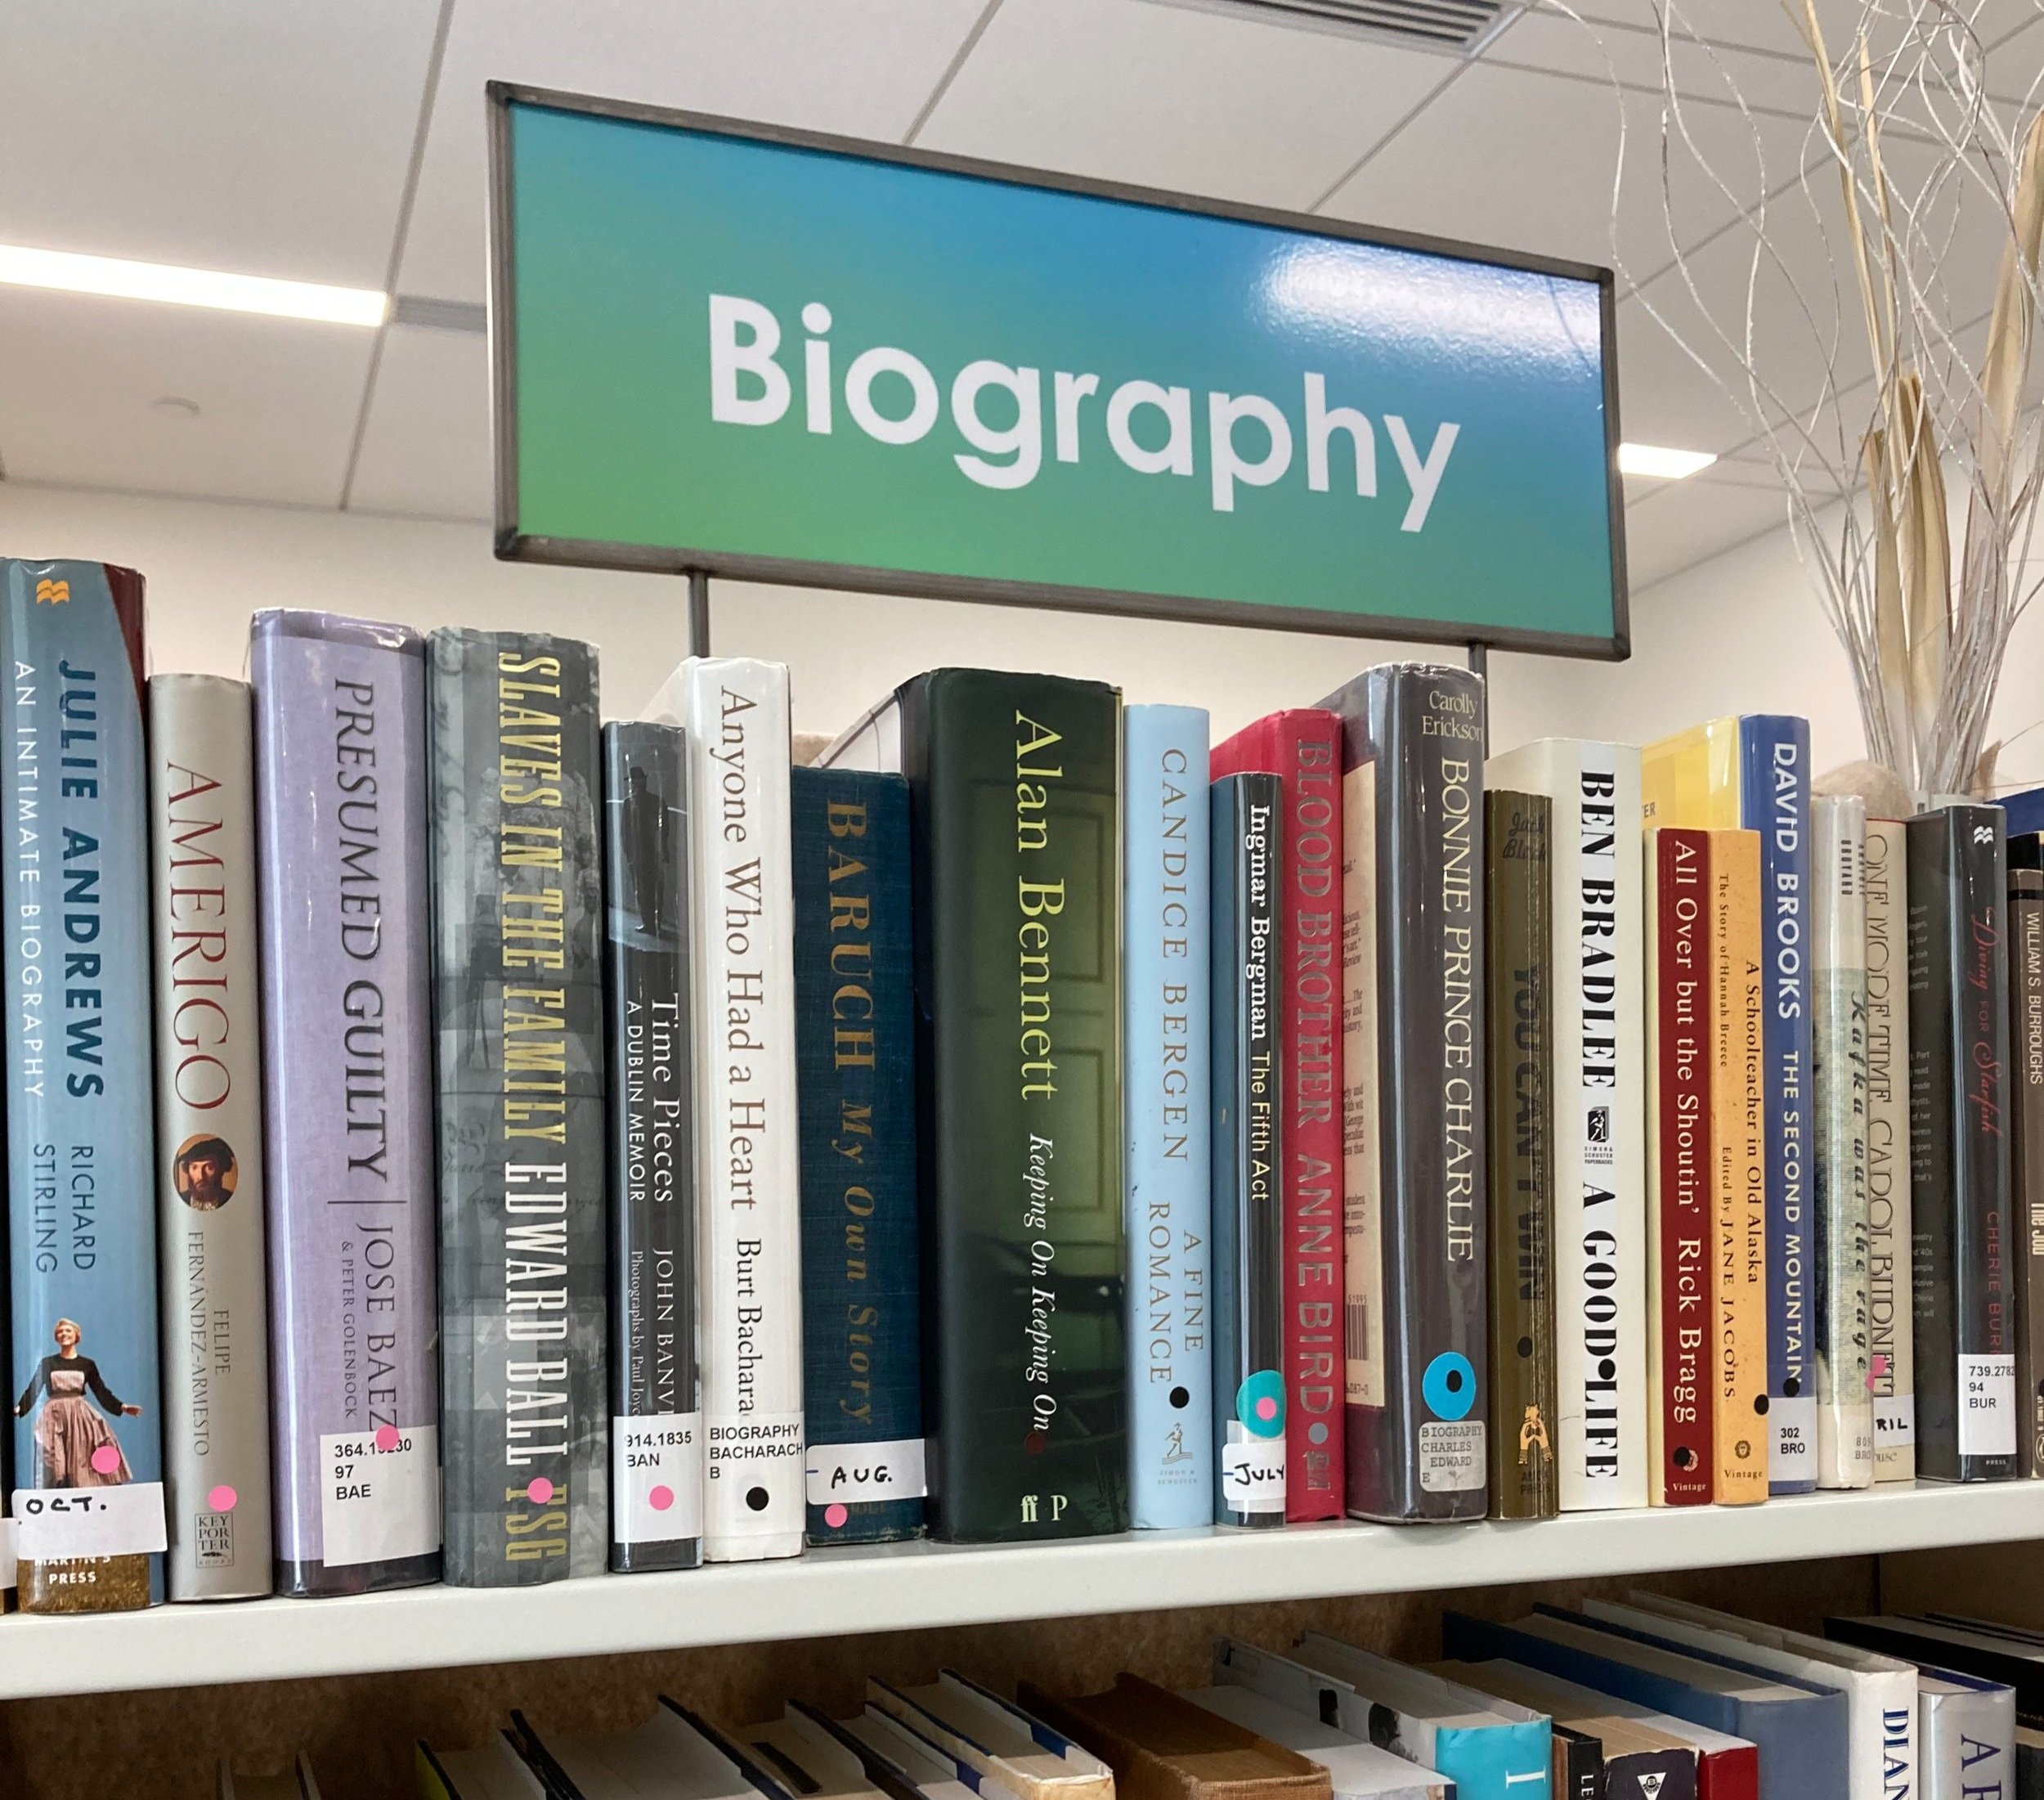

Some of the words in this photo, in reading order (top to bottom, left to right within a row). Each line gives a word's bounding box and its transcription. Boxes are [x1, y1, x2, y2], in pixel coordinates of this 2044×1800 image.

[707, 294, 1461, 532] Biography
[15, 660, 37, 707] AN
[1429, 690, 1478, 720] Carolly
[59, 658, 98, 801] JULIE
[499, 652, 562, 809] SLAVES
[710, 685, 758, 843] Anyone
[1422, 715, 1483, 743] Erickson
[16, 727, 40, 883] INTIMATE
[1015, 710, 1063, 853] Alan
[1296, 738, 1333, 898] BLOOD
[1580, 770, 1615, 859] BEN
[1773, 742, 1798, 853] DAVID
[334, 678, 382, 962] PRESUMED
[500, 823, 563, 872] IN
[1162, 748, 1188, 959] CANDICE
[1441, 756, 1471, 913] BONNIE
[1245, 805, 1271, 909] Ingmar
[1674, 840, 1697, 885] All
[1719, 873, 1728, 897] The
[1841, 839, 1853, 895] BROYARD
[1866, 834, 1889, 904] ONE
[167, 761, 231, 1110] AMERIGO
[502, 888, 564, 971] THE
[724, 856, 761, 955] Who
[827, 799, 876, 1071] BARUCH
[1675, 897, 1698, 970] Over
[1719, 904, 1730, 941] Story
[2027, 912, 2041, 972] WILLIAM
[61, 825, 105, 1098] ANDREWS
[1245, 916, 1271, 1042] Bergman
[1582, 878, 1616, 1088] BRADLEE
[1719, 945, 1729, 962] of
[1746, 960, 1760, 976] A
[1777, 873, 1800, 1020] BROOKS
[1971, 907, 1997, 990] Diving
[2028, 976, 2040, 990] S.
[20, 904, 44, 1098] BIOGRAPHY
[626, 1000, 640, 1017] A
[727, 968, 764, 1052] Had
[1018, 875, 1065, 1101] Bennett
[1297, 909, 1333, 1129] BROTHER
[1443, 925, 1472, 1069] PRINCE
[1514, 965, 1541, 1053] YOU
[1676, 981, 1698, 1026] but
[1719, 966, 1729, 1019] Hannah
[1978, 1002, 1988, 1032] FOR
[503, 985, 567, 1144] FAMILY
[627, 1025, 643, 1103] DUBLIN
[652, 992, 679, 1084] Time
[1163, 983, 1189, 1162] BERGEN
[1251, 1051, 1271, 1095] The
[1676, 1035, 1699, 1082] the
[1746, 981, 1760, 1130] Schoolteacher
[1850, 990, 1867, 1117] Kafka
[2028, 994, 2042, 1085] BURROUGHS
[342, 980, 388, 1184] GUILTY
[728, 1066, 752, 1085] a
[1782, 1051, 1798, 1099] THE
[1969, 1041, 2003, 1138] Starfish
[628, 1114, 645, 1202] MEMOIR
[653, 1098, 682, 1204] Pieces
[729, 1098, 766, 1210] Heart
[831, 1100, 873, 1165] My
[1252, 1101, 1271, 1152] Fifth
[1747, 1138, 1757, 1156] in
[1023, 1133, 1055, 1230] Keeping
[1252, 1160, 1270, 1201] Act
[1445, 1080, 1473, 1262] CHARLIE
[1582, 1182, 1616, 1210] A
[1721, 1196, 1730, 1212] By
[1722, 1147, 1732, 1193] Edited
[1747, 1166, 1763, 1205] Old
[1783, 1114, 1800, 1223] SECOND
[1853, 1138, 1865, 1200] was
[34, 1143, 58, 1273] STIRLING
[70, 1145, 96, 1271] RICHARD
[845, 1186, 876, 1282] Own
[1184, 1230, 1202, 1255] A
[1298, 1153, 1333, 1287] ANNE
[341, 1241, 353, 1252] &
[356, 1223, 395, 1313] JOSE
[504, 1161, 567, 1342] EDWARD
[737, 1237, 762, 1298] Burt
[1031, 1240, 1056, 1277] On
[1518, 1210, 1544, 1301] WIN
[1679, 1237, 1701, 1313] Rick
[1720, 1220, 1734, 1286] JANE
[1747, 1213, 1762, 1284] Alaska
[1856, 1222, 1868, 1273] the
[1987, 1211, 2001, 1292] CHERIE
[341, 1259, 355, 1308] PETER
[628, 1250, 644, 1333] Photographs
[653, 1249, 675, 1323] JOHN
[1149, 1201, 1172, 1385] ROMANCE
[1184, 1268, 1204, 1352] FINE
[1582, 1230, 1618, 1357] GOOD
[1785, 1234, 1802, 1383] MOUNTAIN
[188, 1231, 210, 1457] FERNÁNDEZ-ARMESTO
[213, 1309, 231, 1376] FELIPE
[343, 1314, 356, 1418] GOLENBOCK
[631, 1335, 643, 1354] by
[737, 1304, 763, 1416] Bachara
[840, 1302, 879, 1425] Story
[1025, 1285, 1056, 1384] Keeping
[1298, 1302, 1334, 1416] BIRD
[1721, 1297, 1736, 1398] JACOBS
[1852, 1290, 1867, 1370] rage
[367, 1332, 397, 1431] BAEZ
[632, 1356, 645, 1384] Paul
[632, 1387, 645, 1416] Joyc
[1674, 1326, 1702, 1424] Bragg
[1969, 1366, 2015, 1376] 739.2782
[1969, 1382, 1983, 1392] 94
[1969, 1398, 1997, 1408] BUR
[334, 1439, 412, 1458] 364.130
[505, 1358, 568, 1467] BALL
[625, 1431, 692, 1448] 914.1835
[710, 1424, 800, 1440] BIOGRAPHY
[1033, 1394, 1057, 1432] On
[1421, 1425, 1483, 1438] BIOGRAPHY
[1422, 1442, 1472, 1453] CHARLES
[1584, 1377, 1619, 1479] LIFE
[1780, 1427, 1800, 1439] 302
[1780, 1443, 1805, 1455] BRO
[335, 1465, 354, 1479] 97
[627, 1453, 660, 1467] BAN
[710, 1443, 803, 1460] BACHARACH
[710, 1466, 720, 1479] B
[831, 1466, 892, 1489] AUG.
[1234, 1463, 1284, 1486] JULY
[1422, 1472, 1430, 1483] E
[1430, 1456, 1472, 1468] EDWARD
[1673, 1482, 1706, 1493] Vintage
[1724, 1470, 1764, 1479] Vintage
[26, 1496, 106, 1515] OCT.
[199, 1515, 229, 1527] KEY
[336, 1484, 371, 1500] BAE
[198, 1539, 230, 1551] TER
[199, 1528, 230, 1538] POR
[48, 1572, 96, 1585] PRESS
[1580, 1773, 1594, 1800] LE
